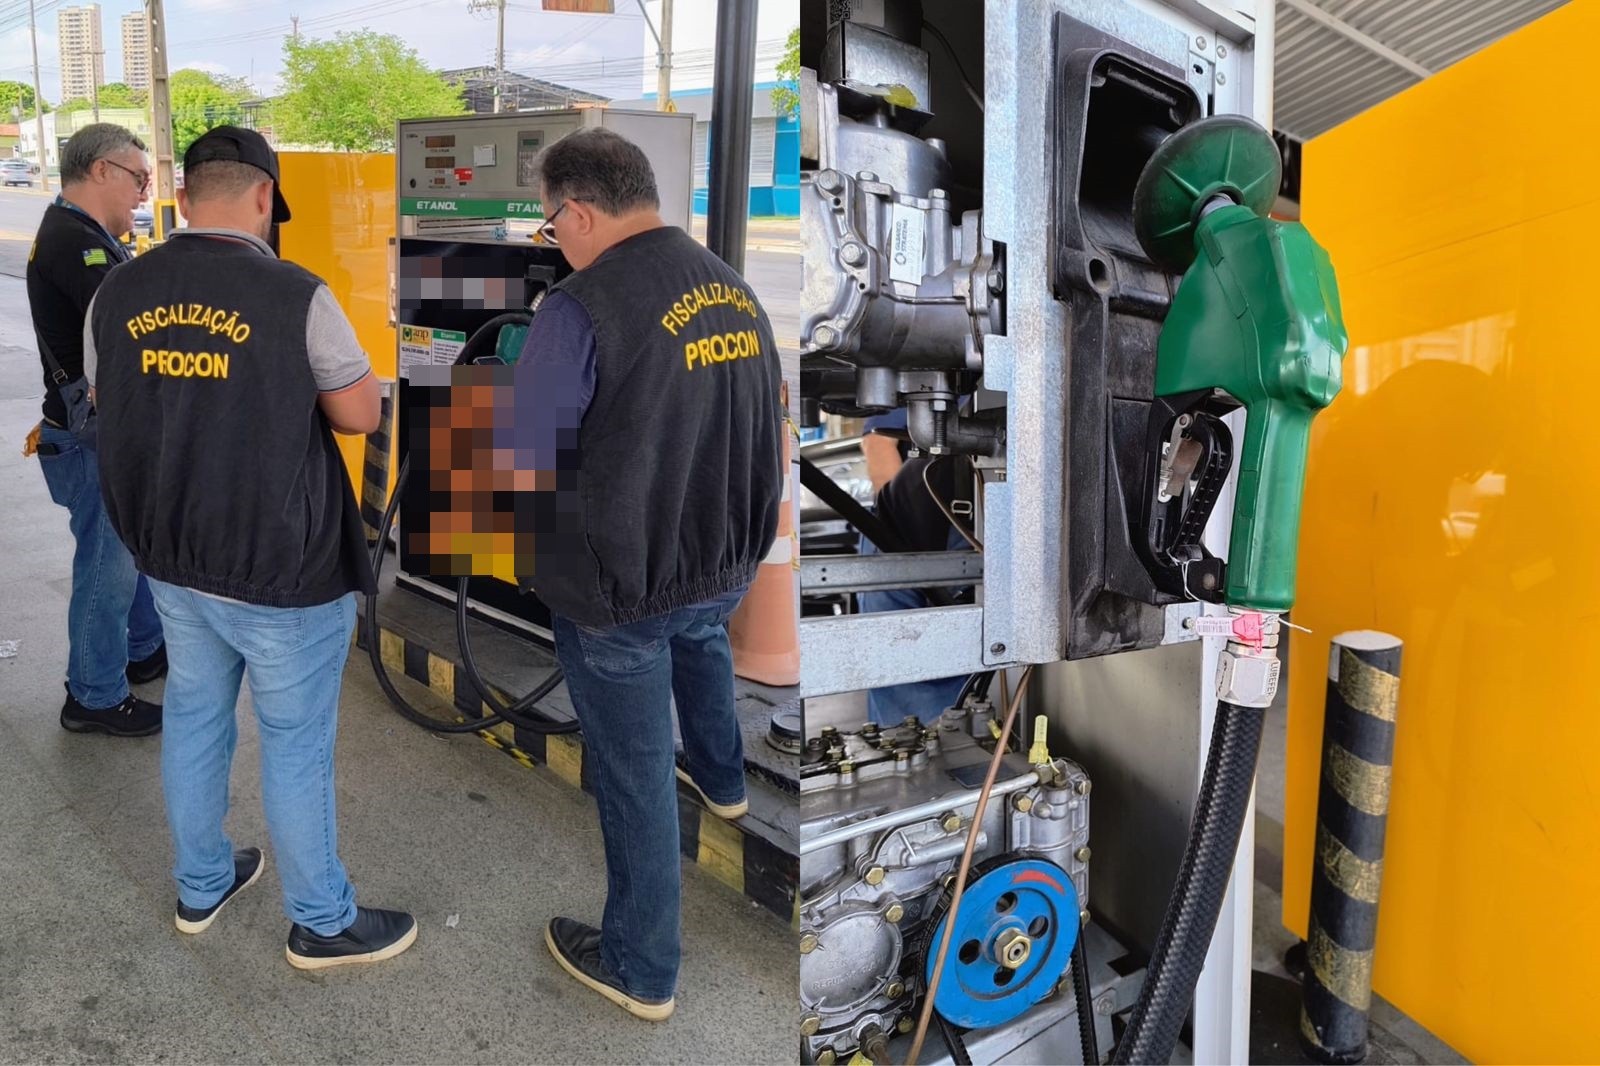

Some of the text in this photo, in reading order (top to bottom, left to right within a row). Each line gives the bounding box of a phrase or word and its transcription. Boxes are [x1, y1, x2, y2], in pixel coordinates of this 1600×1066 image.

[416, 200, 458, 211] ETANOL
[507, 202, 544, 214] ETAN
[127, 303, 250, 343] FISCALIZAÇÃO
[662, 283, 757, 336] FISCALIZAÇÃO
[142, 349, 230, 379] PROCON
[685, 330, 760, 371] PROCON
